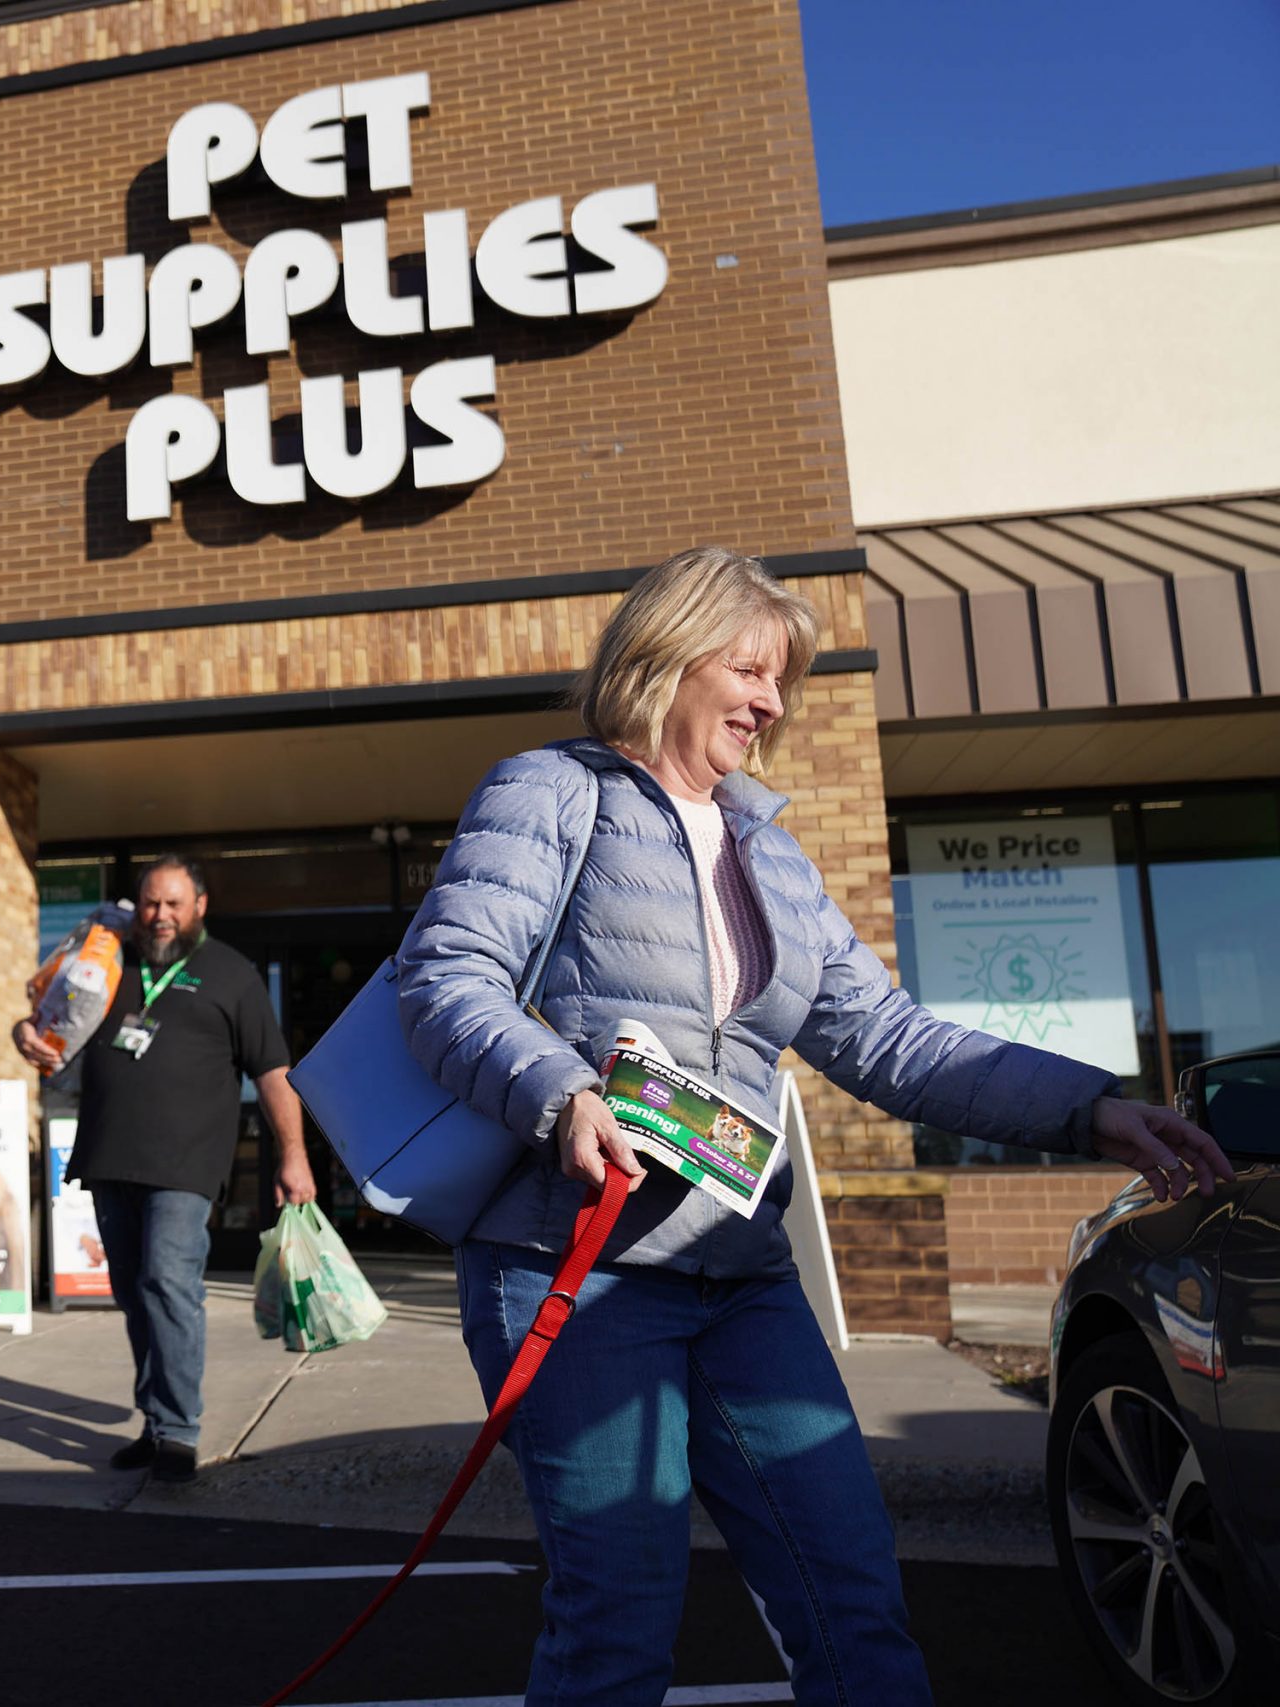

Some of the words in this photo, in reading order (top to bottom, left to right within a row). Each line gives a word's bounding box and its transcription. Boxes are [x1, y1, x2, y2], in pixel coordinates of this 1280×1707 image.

[167, 71, 430, 222] PET
[125, 354, 507, 523] PLUS
[938, 837, 989, 862] We
[998, 833, 1082, 859] Price
[962, 862, 1063, 890] Match
[933, 896, 977, 912] Online
[980, 898, 990, 909] &
[994, 895, 1031, 910] Local
[1034, 893, 1099, 907] Retailers
[622, 1052, 642, 1063] PET
[642, 1058, 687, 1087] SUPPLIES
[686, 1081, 712, 1102] PLUS
[646, 1083, 671, 1099] Free
[605, 1097, 681, 1136] Opening!
[628, 1125, 645, 1134] scaly
[651, 1131, 677, 1151] feathery
[677, 1148, 701, 1166] friends.
[696, 1142, 727, 1163] October
[726, 1161, 738, 1171] 26
[738, 1168, 745, 1176] &
[744, 1172, 756, 1182] 27
